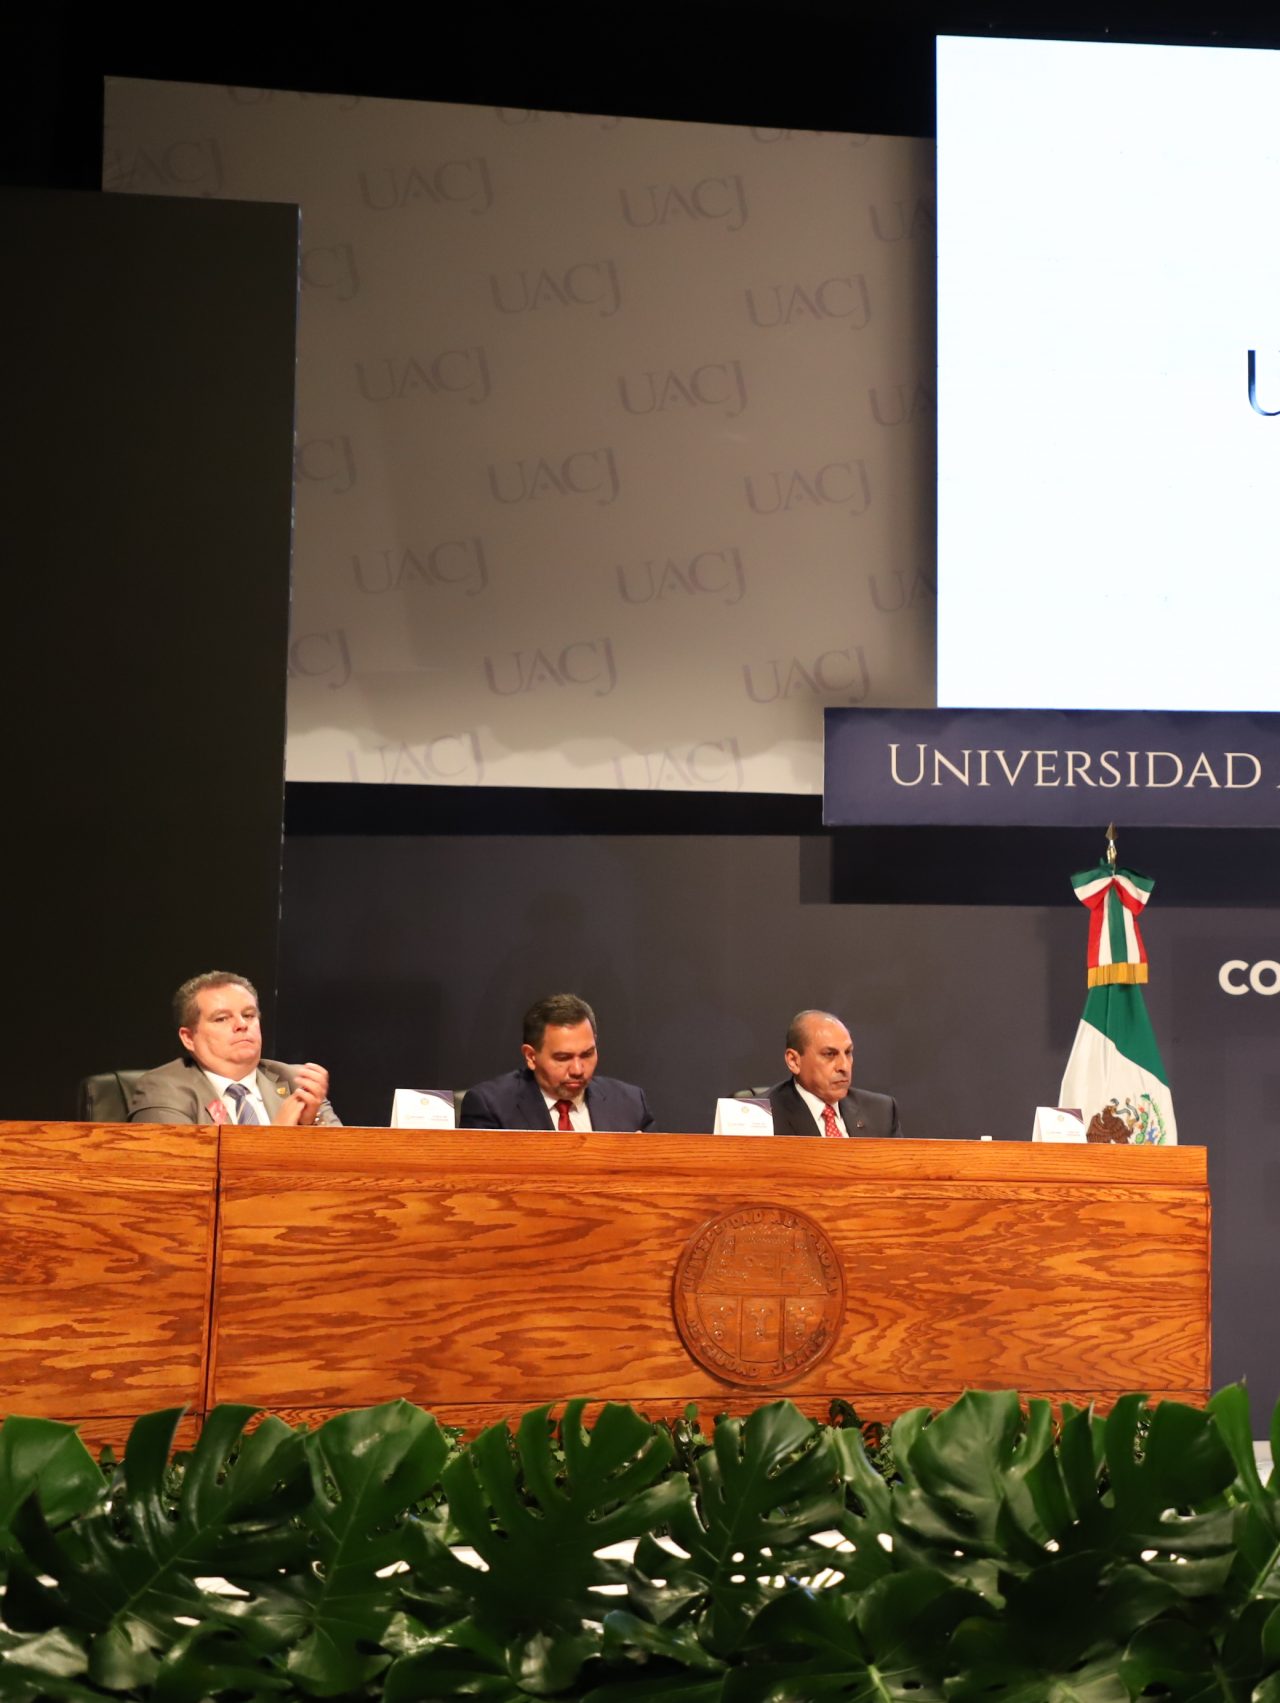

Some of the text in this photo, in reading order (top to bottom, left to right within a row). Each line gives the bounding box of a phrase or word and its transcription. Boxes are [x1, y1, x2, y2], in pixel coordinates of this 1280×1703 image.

[359, 157, 495, 213] UACJ
[620, 174, 748, 231] UACJ
[869, 200, 936, 244] UA
[299, 245, 361, 302] CJ
[490, 258, 622, 317] UACJ
[745, 273, 872, 331] UACJ
[355, 346, 491, 405] UACJ
[618, 359, 747, 416] UACJ
[869, 381, 936, 427] UA
[295, 435, 357, 493] CJ
[488, 447, 620, 505] UACJ
[745, 459, 872, 516] UACJ
[353, 537, 489, 597] UACJ
[616, 548, 746, 605] UACJ
[869, 569, 936, 614] UA
[288, 629, 353, 689] CJ
[484, 636, 616, 696] UACJ
[742, 645, 871, 705] UACJ
[888, 743, 1262, 789] UNIVERSIDAD
